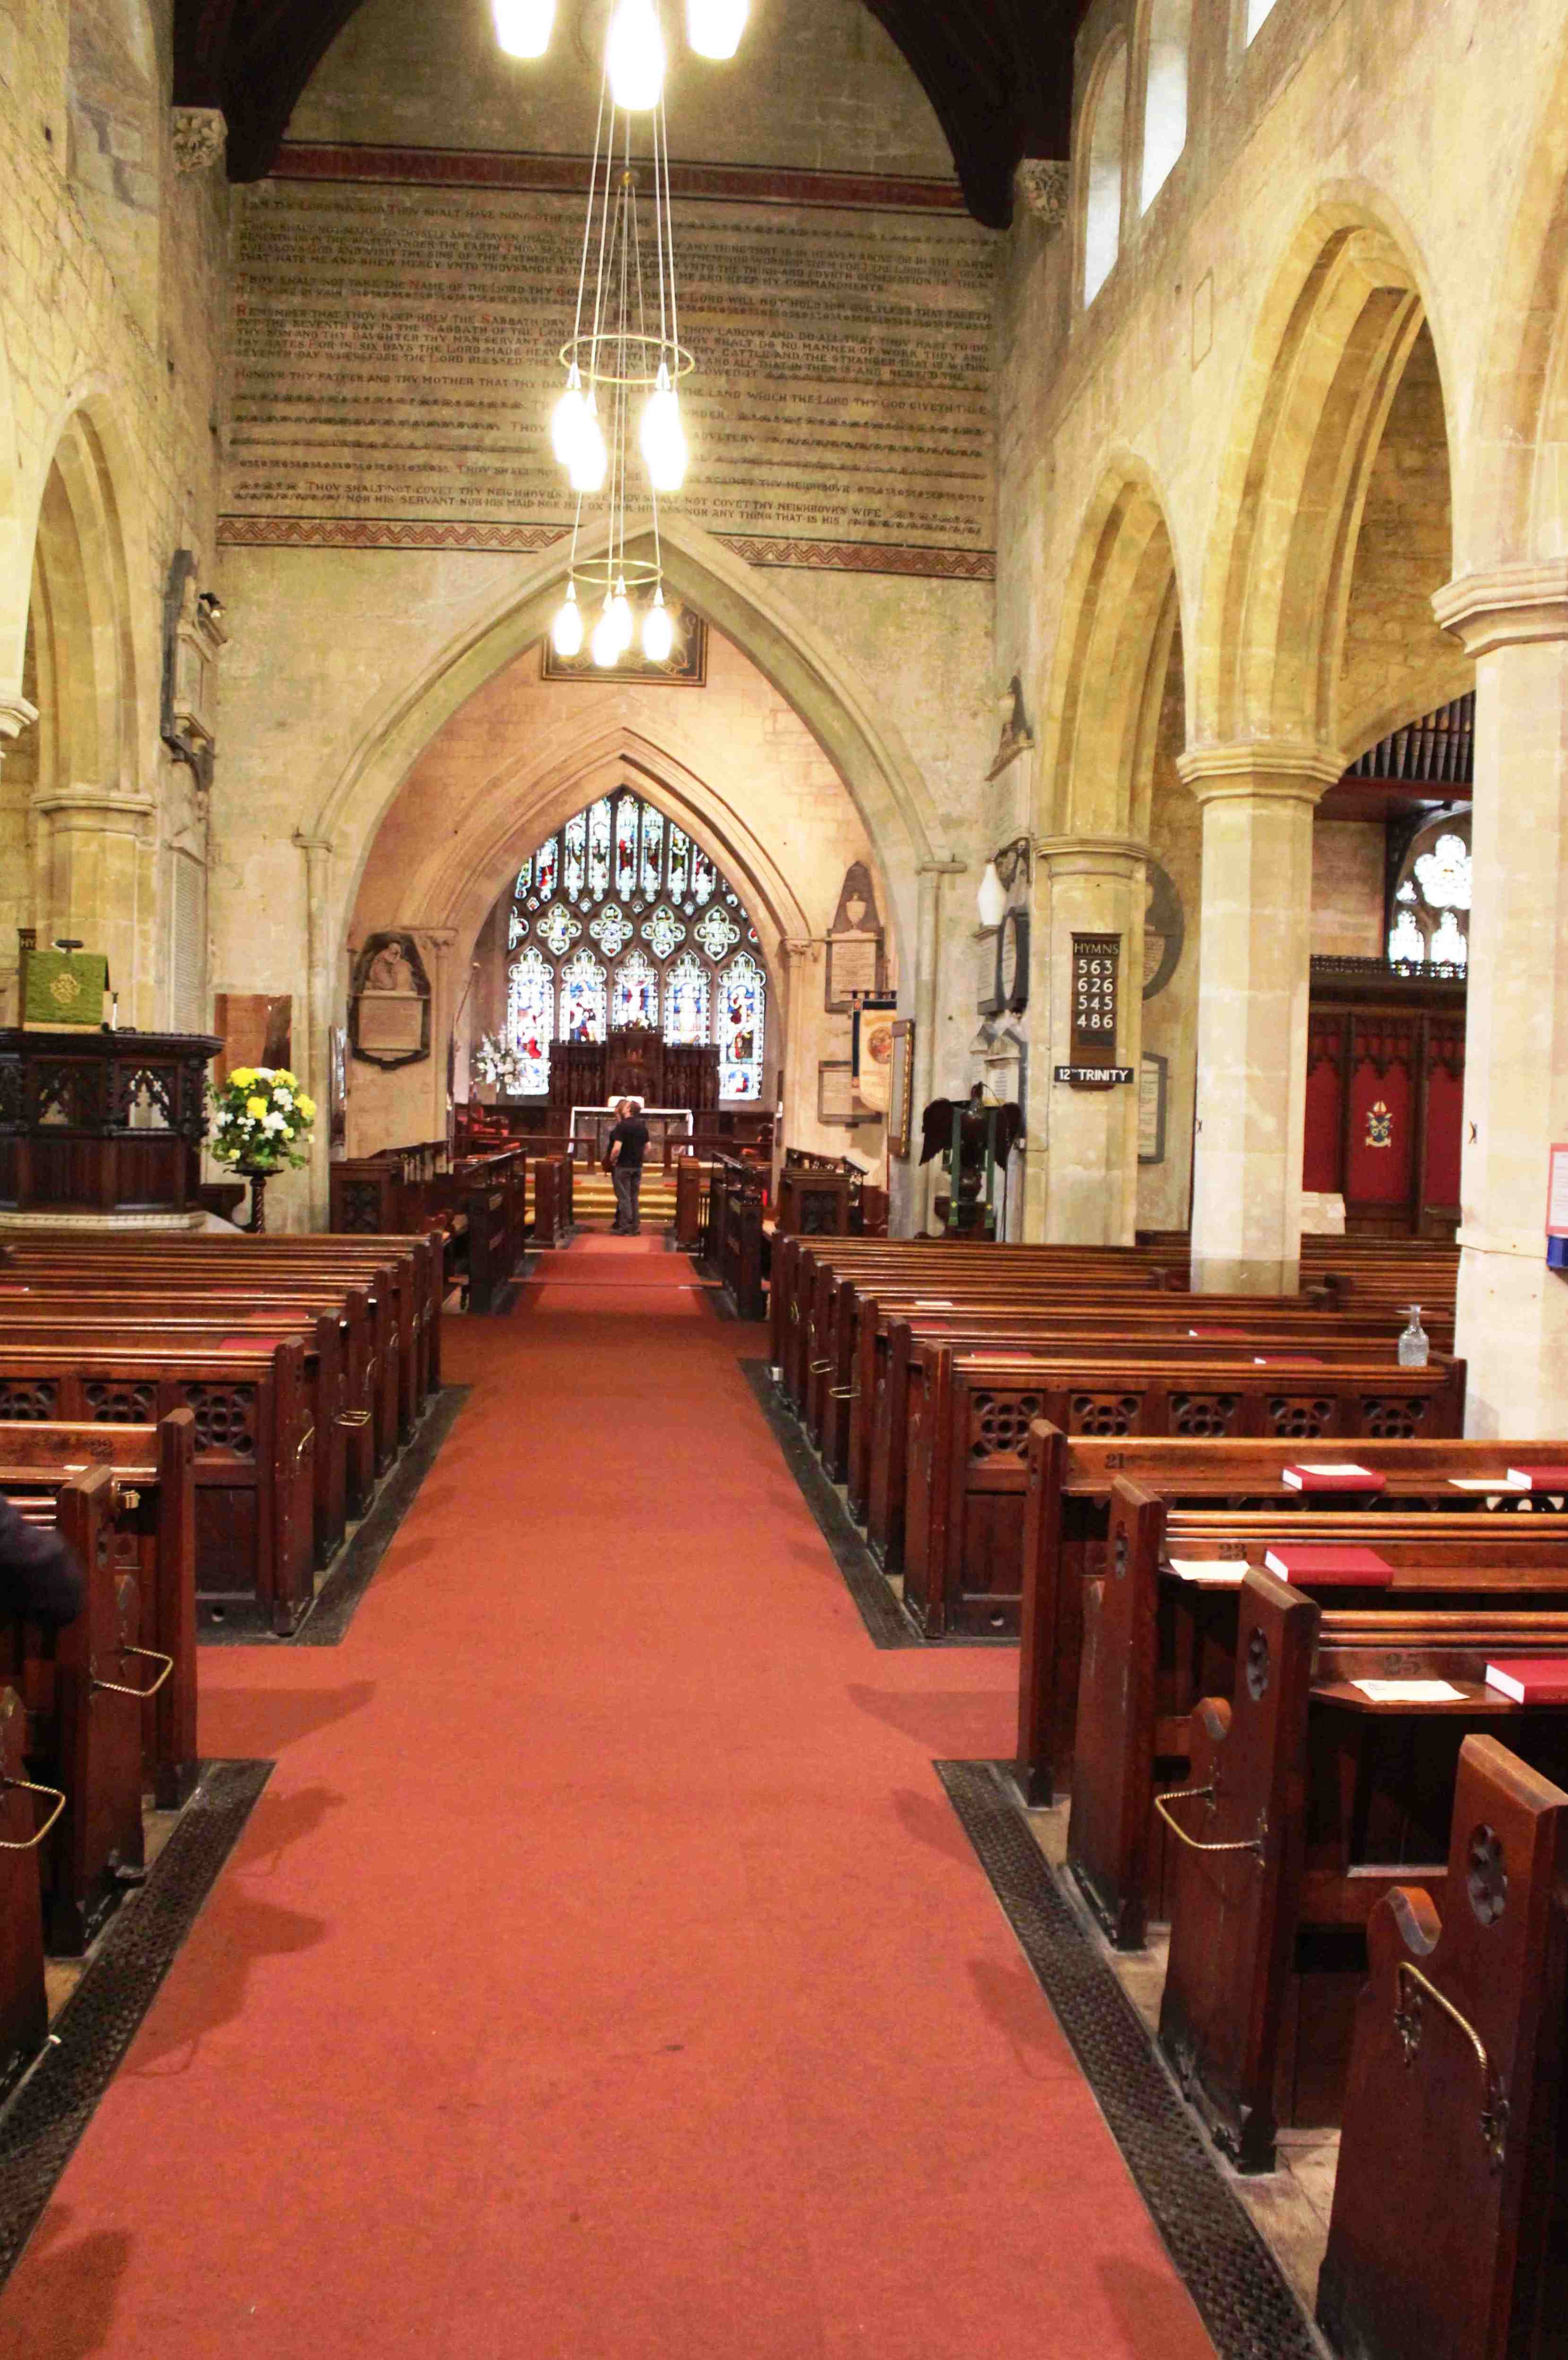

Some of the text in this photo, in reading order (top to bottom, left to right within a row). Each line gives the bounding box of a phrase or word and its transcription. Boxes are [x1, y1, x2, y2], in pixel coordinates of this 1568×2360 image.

[1074, 942, 1119, 955] HYMNS
[1078, 960, 1112, 974] 563
[1078, 978, 1113, 993] 626
[1078, 996, 1112, 1010] 545
[1077, 1014, 1113, 1028] 486
[1078, 1069, 1128, 1081] TRINITY
[1105, 1452, 1126, 1469] 21
